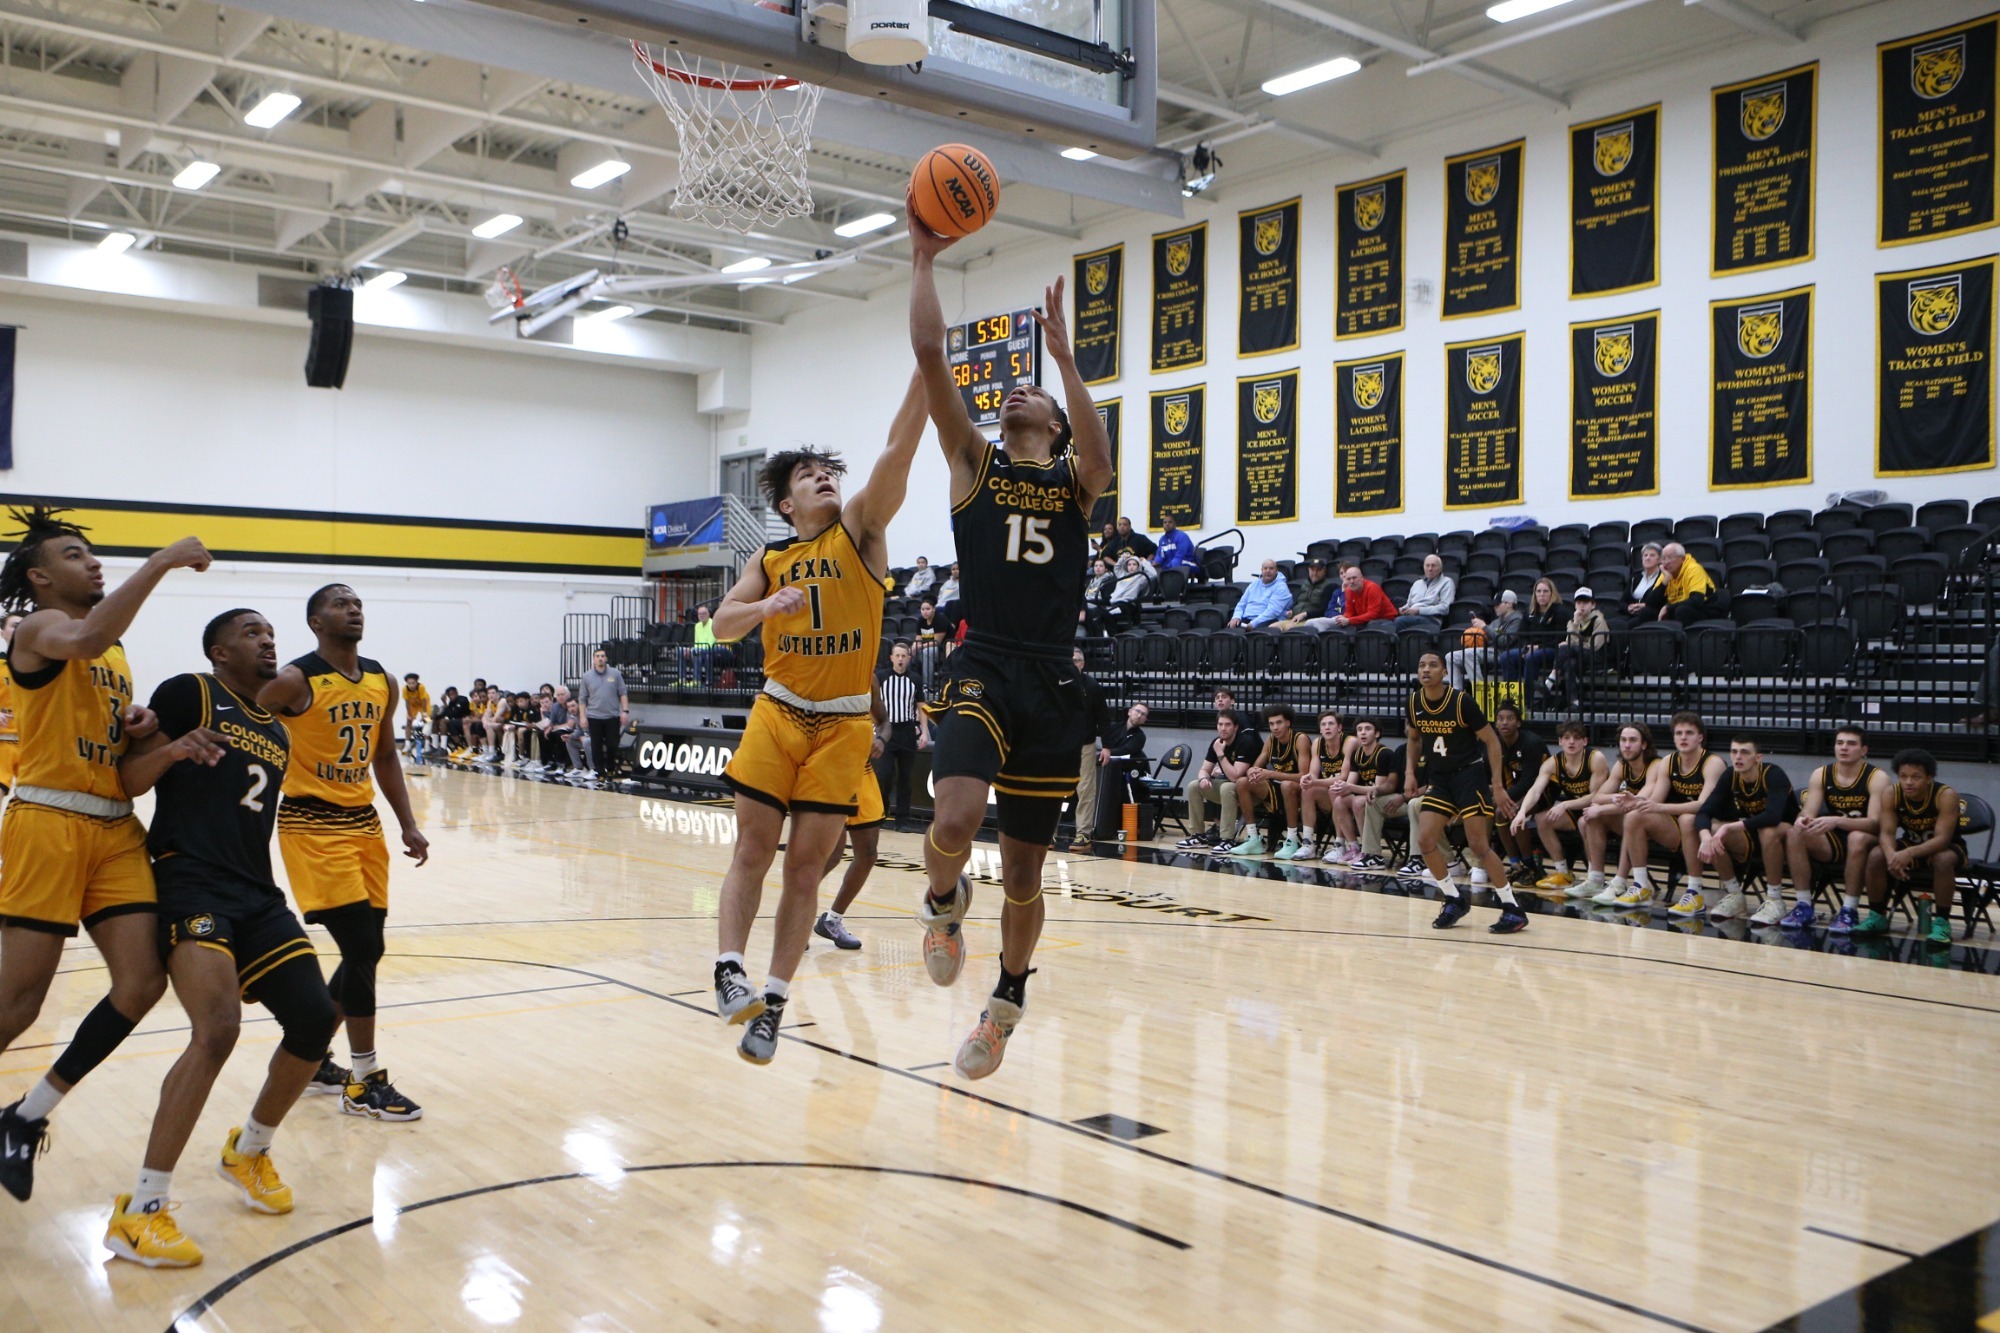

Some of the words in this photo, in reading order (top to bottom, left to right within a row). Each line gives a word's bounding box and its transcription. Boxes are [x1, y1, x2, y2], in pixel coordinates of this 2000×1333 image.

[1918, 105, 1957, 122] MEN'S
[1890, 123, 1933, 140] TRACK
[1935, 120, 1945, 131] &
[1948, 109, 1986, 127] FIELD
[1746, 146, 1780, 163] MEN'S
[1719, 161, 1766, 178] SWIMMING
[1767, 158, 1775, 168] &
[1776, 150, 1809, 166] DIVING
[963, 154, 995, 212] Wilson
[1591, 179, 1636, 198] WOMEN'S
[945, 178, 977, 219] NCAA
[1595, 191, 1632, 208] SOCCER
[1469, 210, 1495, 223] MEN'S
[1465, 219, 1497, 234] SOCCER
[1358, 235, 1381, 247] MEN'S
[1351, 243, 1388, 258] LACROSSE
[1258, 259, 1280, 270] MEN'S
[977, 315, 1009, 343] 5:50
[1007, 338, 1030, 351] GUEST
[1905, 342, 1966, 357] WOMEN'S
[1010, 352, 1031, 376] 51
[1888, 359, 1931, 370] TRACK
[1933, 357, 1944, 367] &
[1947, 352, 1983, 366] FIELD
[984, 362, 992, 379] 2
[1735, 363, 1786, 379] WOMEN'S
[1592, 382, 1637, 396] WOMEN'S
[1716, 379, 1763, 391] SWIMMING
[1764, 377, 1772, 386] &
[1773, 370, 1805, 385] DIVING
[975, 392, 990, 410] 45
[1471, 400, 1497, 411] MEN'S
[1595, 394, 1633, 407] SOCCER
[1351, 414, 1386, 425] WOMEN'S
[1467, 410, 1500, 422] SOCCER
[1257, 429, 1278, 439] MEN'S
[1350, 423, 1388, 436] LACROSSE
[1163, 441, 1191, 449] WOMEN'S
[1259, 436, 1287, 447] HOCKEY
[988, 476, 1071, 499] COLORADO
[994, 493, 1065, 512] COLLEGE
[1005, 513, 1054, 564] 15
[805, 584, 823, 631] 1
[778, 628, 863, 657] LUTHERAN
[109, 697, 122, 745] 3
[1416, 720, 1457, 728] COLORADO
[220, 722, 287, 761] COLORADO
[338, 724, 373, 764] 23
[1433, 736, 1448, 757] 4
[230, 737, 284, 771] COLLEGE
[640, 741, 733, 776] COLORAD
[240, 764, 268, 813] 2
